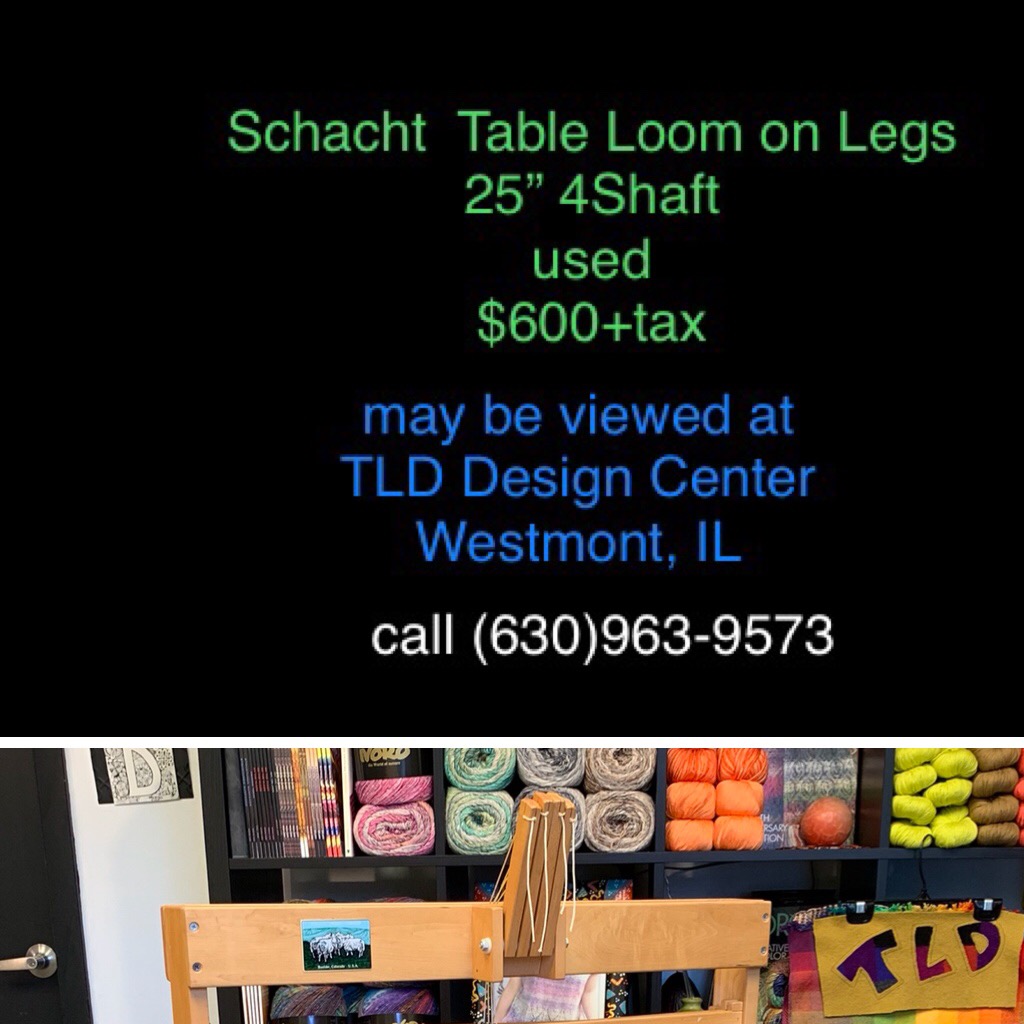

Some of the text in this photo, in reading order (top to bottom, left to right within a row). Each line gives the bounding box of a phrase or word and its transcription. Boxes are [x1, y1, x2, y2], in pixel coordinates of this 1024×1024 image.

[359, 748, 411, 763] NORO
[769, 952, 787, 961] LOR
[836, 922, 1002, 994] TLD
